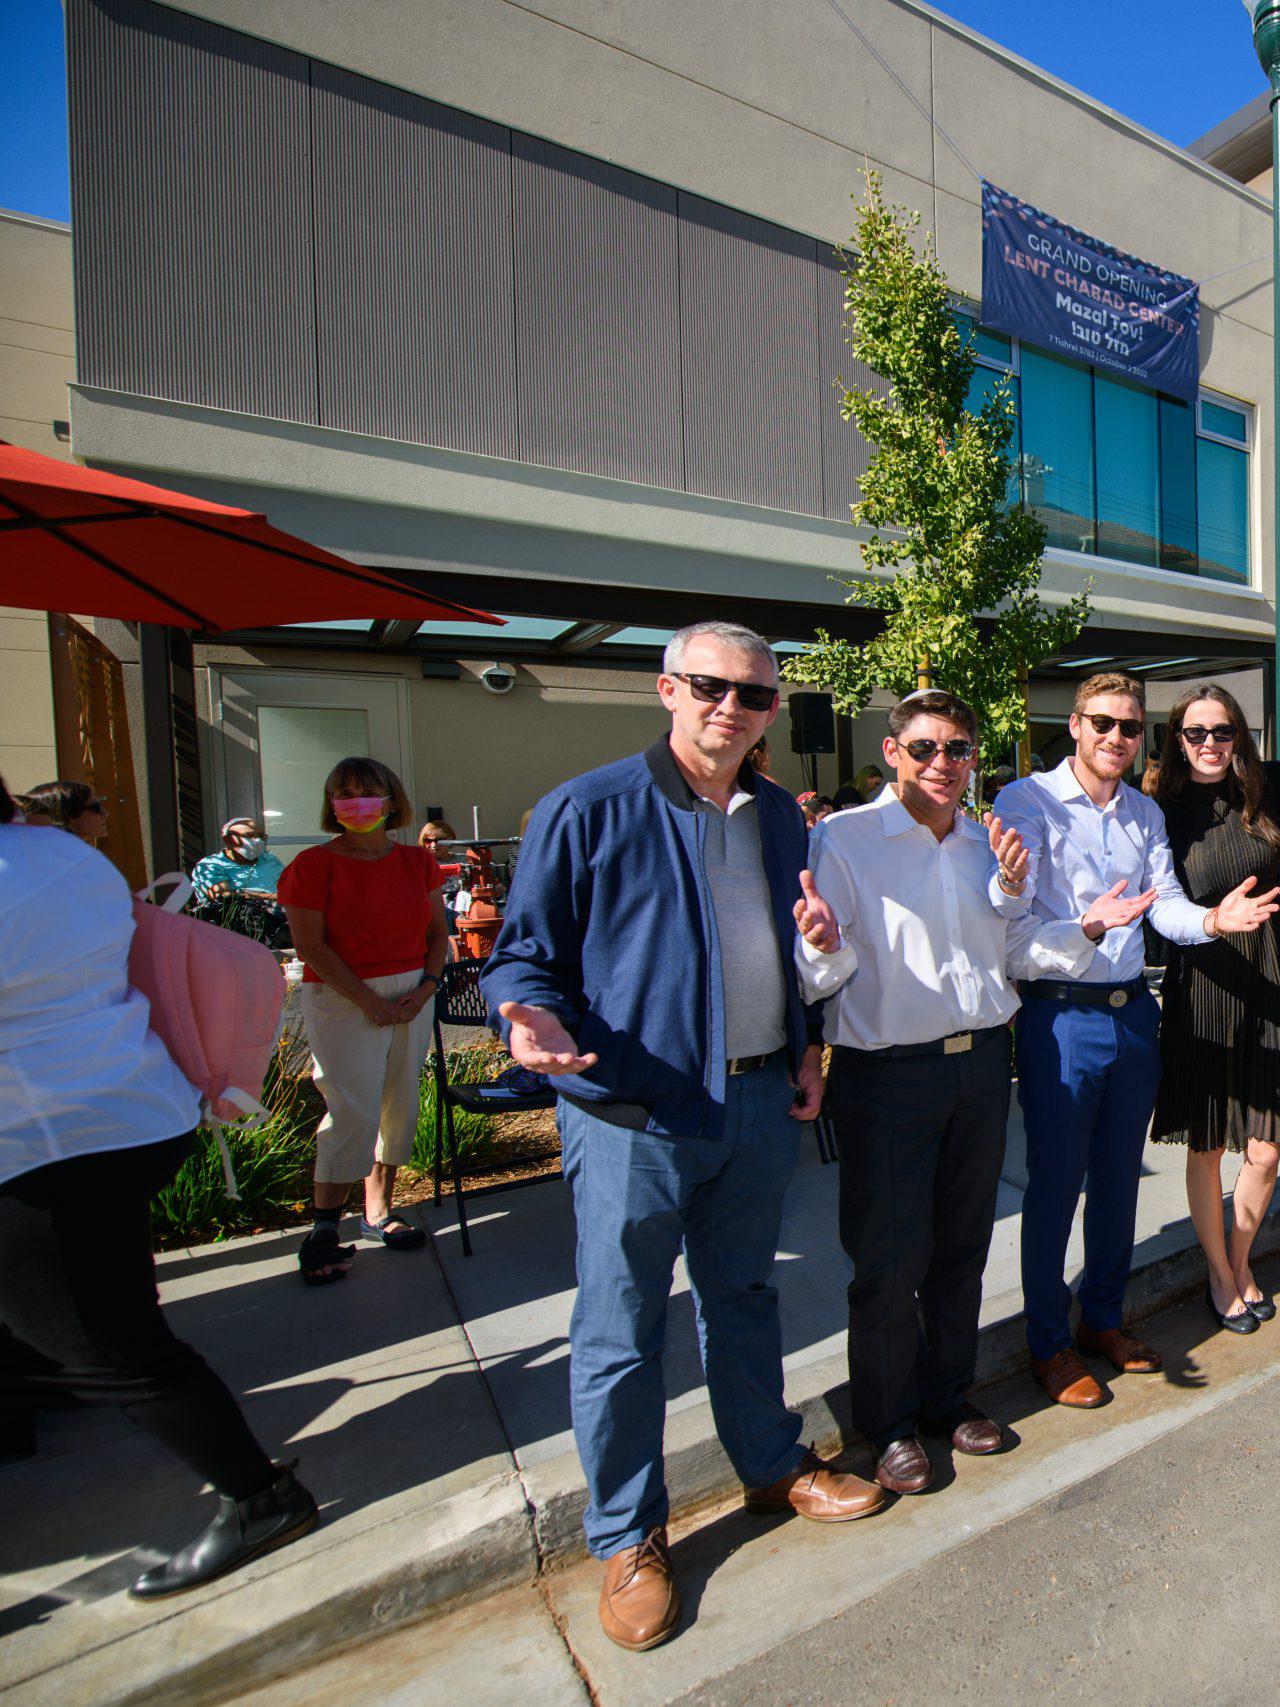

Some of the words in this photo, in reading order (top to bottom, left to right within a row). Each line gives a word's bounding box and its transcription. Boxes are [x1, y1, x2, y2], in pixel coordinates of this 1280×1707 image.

[1004, 245, 1050, 279] LENT
[1054, 269, 1125, 311] CHABAD
[1128, 301, 1184, 336] CENTER
[1028, 234, 1091, 273] GRAND
[1096, 265, 1167, 308] OPENING
[1056, 291, 1107, 327] Mazal
[1110, 313, 1143, 341] Tov!
[1055, 337, 1078, 352] Tishrei
[1079, 346, 1095, 359] 5783
[1100, 354, 1126, 370] October
[1105, 332, 1129, 356] מזל
